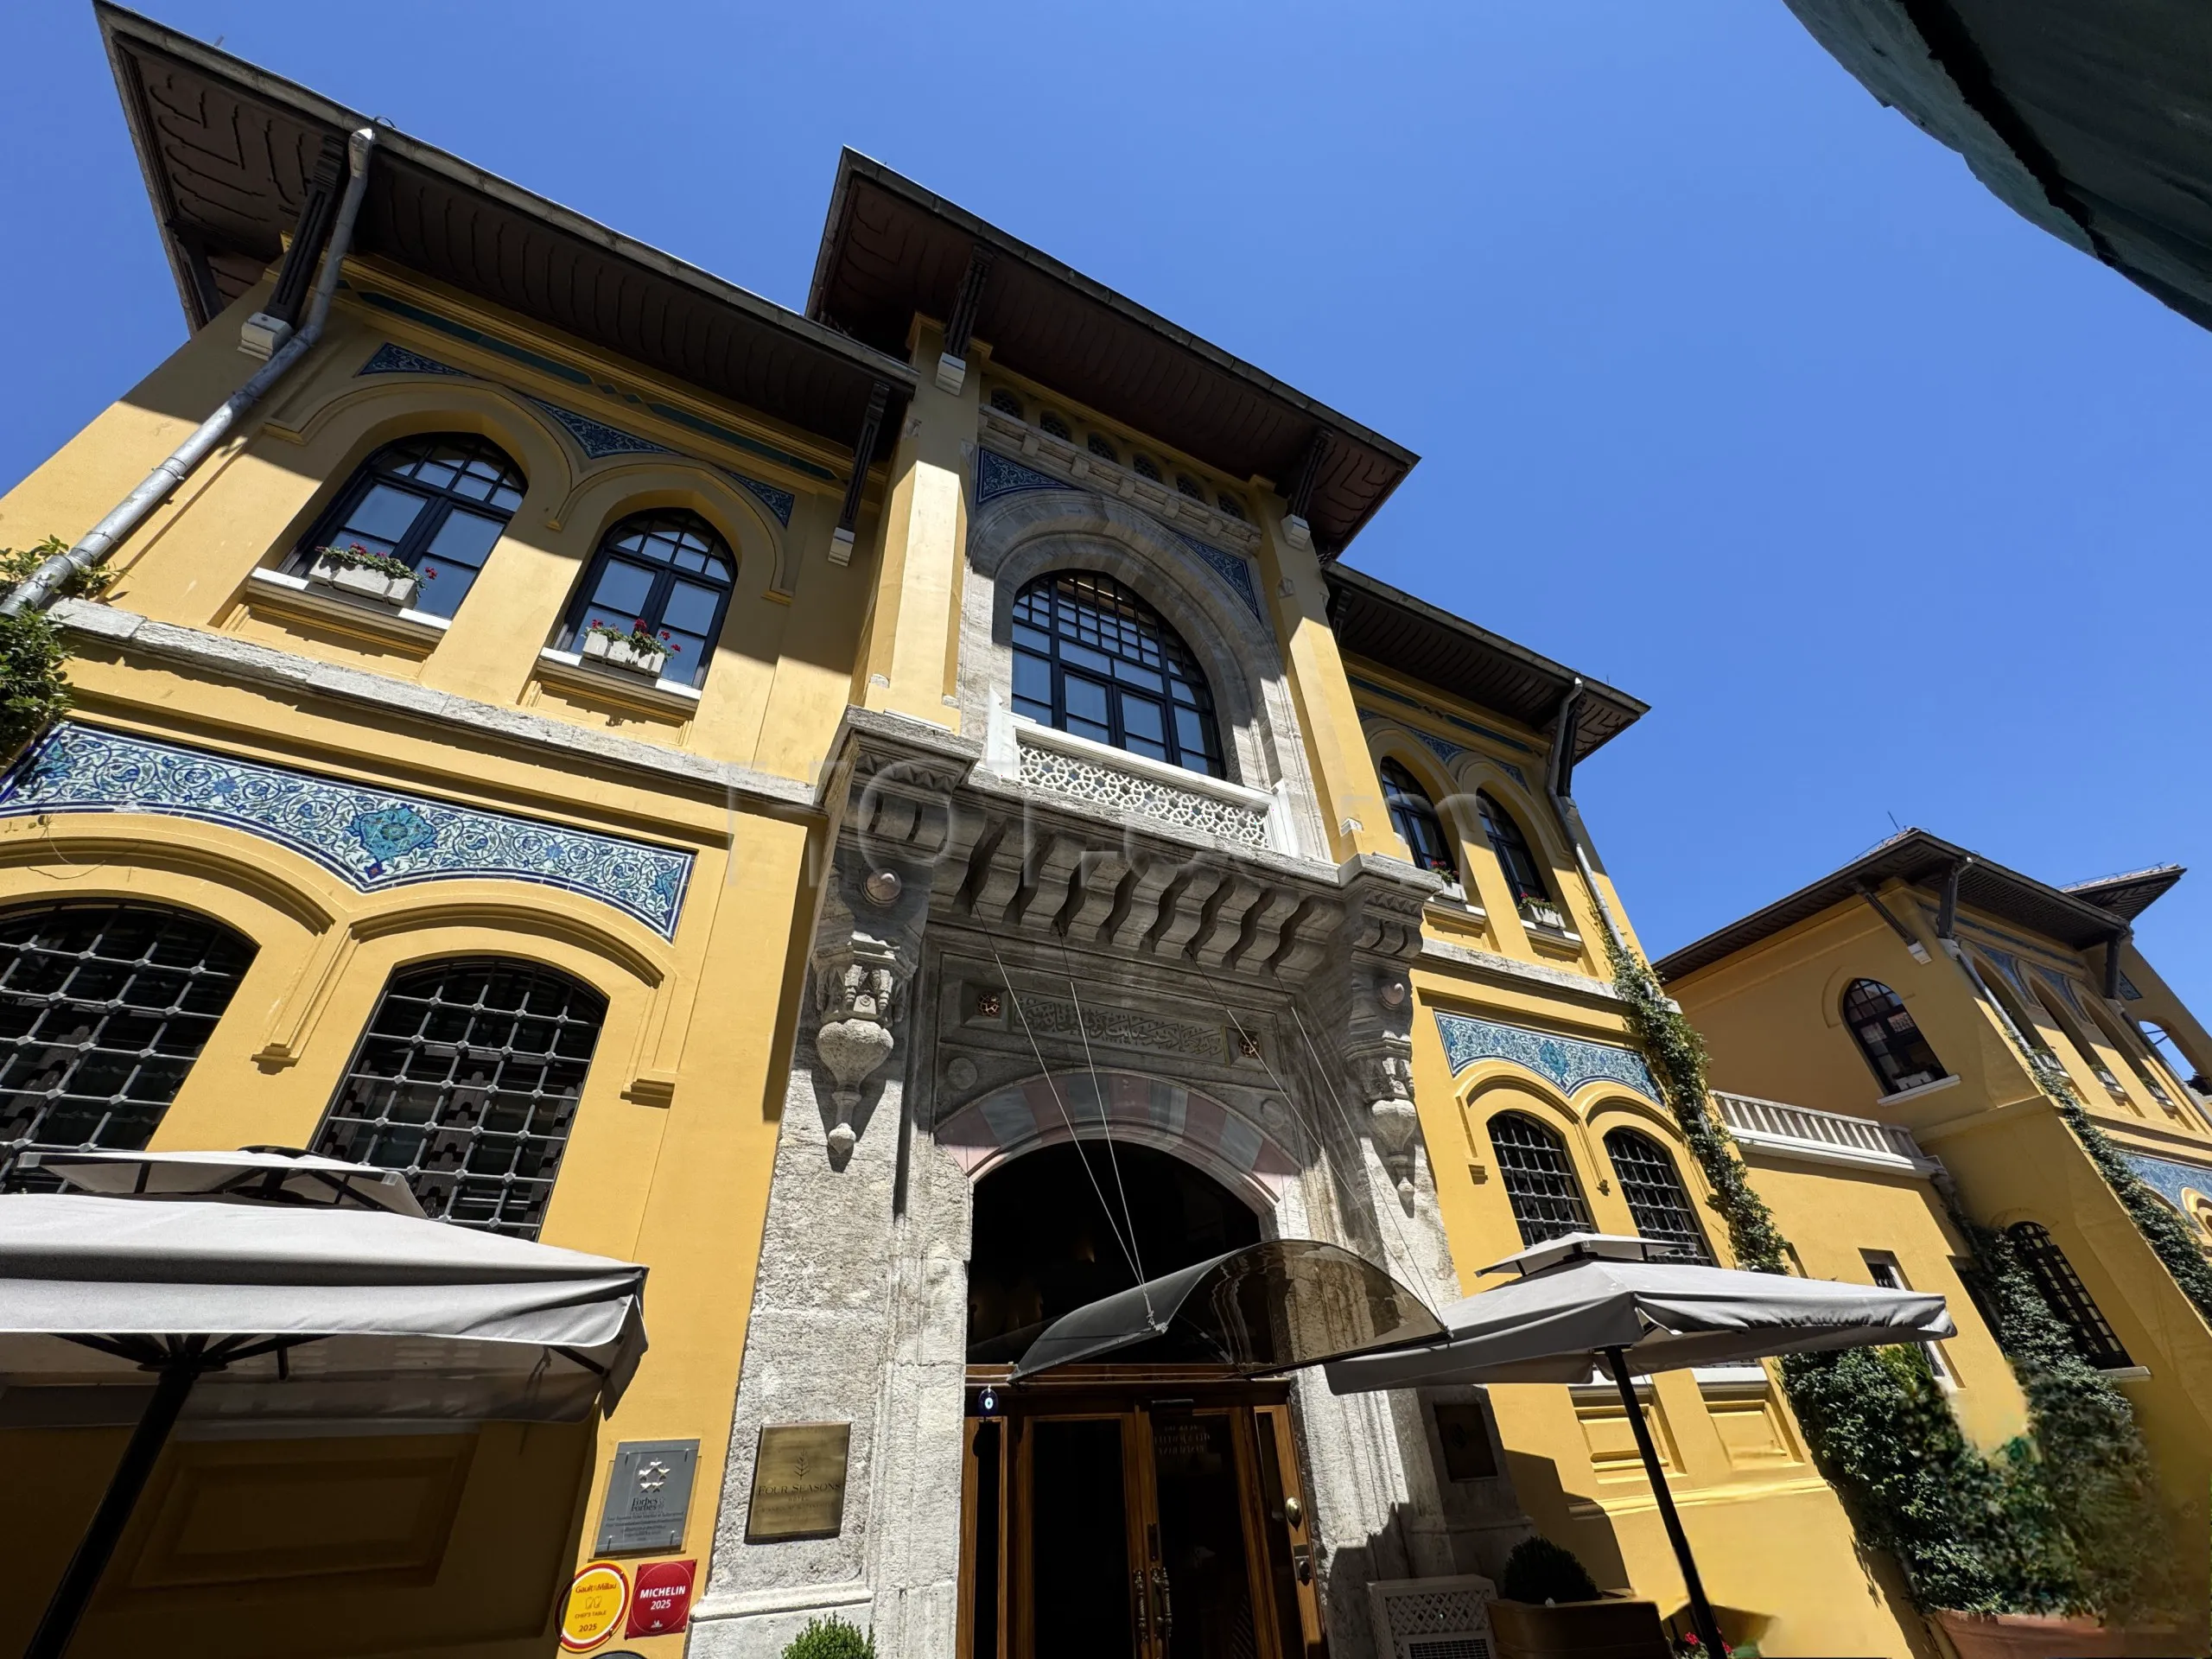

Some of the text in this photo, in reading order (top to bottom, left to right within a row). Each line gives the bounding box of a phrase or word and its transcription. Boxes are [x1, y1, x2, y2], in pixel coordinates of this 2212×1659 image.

[758, 1482, 841, 1496] FOUR SEASONS
[632, 1497, 658, 1507] Forbes
[639, 1585, 686, 1599] MICHELIN
[650, 1599, 671, 1611] 2025
[579, 1623, 598, 1633] 2025
